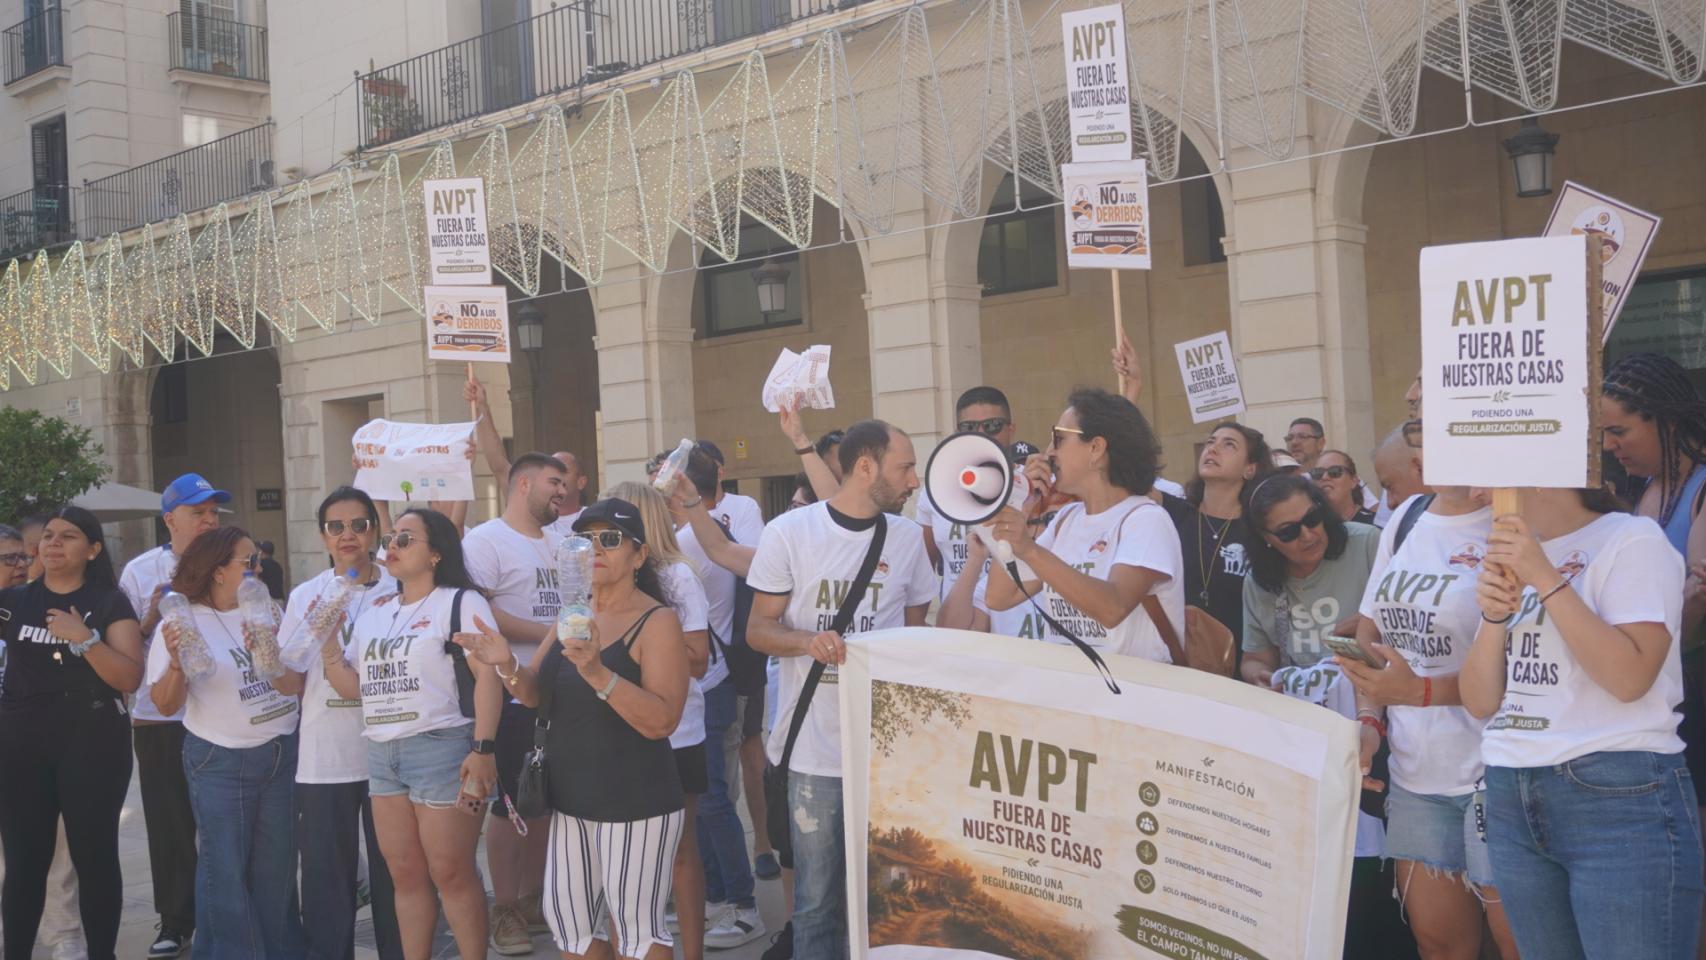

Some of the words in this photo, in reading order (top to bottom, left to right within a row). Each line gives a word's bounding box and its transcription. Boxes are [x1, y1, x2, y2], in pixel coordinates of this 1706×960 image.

[1073, 20, 1116, 62] AVPT
[1077, 65, 1104, 87] FUERA
[1105, 63, 1117, 84] DE
[1071, 88, 1105, 109] NUESTRAS
[1105, 86, 1127, 105] CASAS
[433, 188, 476, 215] AVPT
[1100, 186, 1118, 205] NO
[1120, 194, 1126, 203] A
[1126, 193, 1137, 203] LOS
[437, 218, 463, 232] FUERA
[466, 217, 476, 231] DE
[1096, 206, 1143, 223] DERRIBOS
[432, 234, 464, 248] NUESTRAS
[465, 234, 486, 247] CASAS
[1077, 233, 1093, 245] AVPT
[460, 304, 478, 317] NO
[486, 309, 497, 317] LOS
[1451, 273, 1552, 327] AVPT
[457, 317, 503, 330] DERRIBOS
[1184, 341, 1224, 369] AVPT
[1458, 331, 1515, 360] FUERA
[1522, 329, 1545, 358] DE
[1187, 378, 1218, 394] NUESTRAS
[1217, 373, 1237, 387] CASAS
[1190, 366, 1215, 382] FUERA
[1215, 363, 1227, 376] DE
[1442, 361, 1513, 388] NUESTRAS
[1518, 359, 1564, 385] CASAS
[1471, 408, 1513, 419] PIDIENDO
[1515, 407, 1534, 418] UNA
[1452, 422, 1526, 434] REGULARIZACIÓN
[1528, 422, 1555, 433] JUSTA
[816, 579, 883, 612] AVT
[1374, 570, 1460, 607] AVPT
[1291, 596, 1340, 630] SO
[1380, 608, 1418, 633] FUERA
[1018, 614, 1046, 640] AV
[364, 635, 418, 662] AVPT
[1420, 635, 1452, 658] ASAS
[1520, 632, 1541, 659] DE
[367, 662, 397, 681] FUERA
[398, 660, 408, 677] DE
[1512, 660, 1559, 685] CASAS
[239, 680, 275, 701] NUESTRA
[361, 680, 397, 697] NUESTRAS
[1514, 719, 1543, 729] JUSTA
[969, 730, 1098, 813] AVPT
[1155, 760, 1255, 799] MANIFESTACIÓN
[993, 799, 1046, 830] FUERA
[1051, 811, 1071, 837] DE
[1167, 797, 1211, 815] DEFENDEMOS
[1211, 810, 1241, 826] NUESTROS
[1242, 821, 1271, 837] HOGARES
[962, 818, 1046, 855] NUESTRAS
[1051, 837, 1103, 870] CASAS
[1166, 826, 1208, 846] DEFENDEMOS
[1215, 842, 1246, 859] NUESTRAS
[1246, 853, 1272, 870] FAMILIAS
[1002, 866, 1042, 887] PIDIENDO
[1044, 877, 1064, 891] UNA
[1164, 856, 1206, 876] DEFENDEMOS
[1206, 871, 1235, 886] NUESTRO
[1235, 882, 1263, 898] ENTORNO
[982, 874, 1055, 902] REGULARIZACIÓN
[1056, 894, 1084, 910] JUSTA
[1180, 891, 1208, 907] PEDIMOS
[1208, 902, 1217, 910] LO
[1217, 905, 1231, 915] QUE
[1231, 910, 1239, 918] ES
[1240, 913, 1258, 927] JUSTO
[1137, 929, 1149, 943] EL
[1150, 934, 1188, 957] CAMPO
[1139, 916, 1168, 934] SOMOS
[1206, 941, 1220, 954] NO
[1220, 947, 1233, 960] UN
